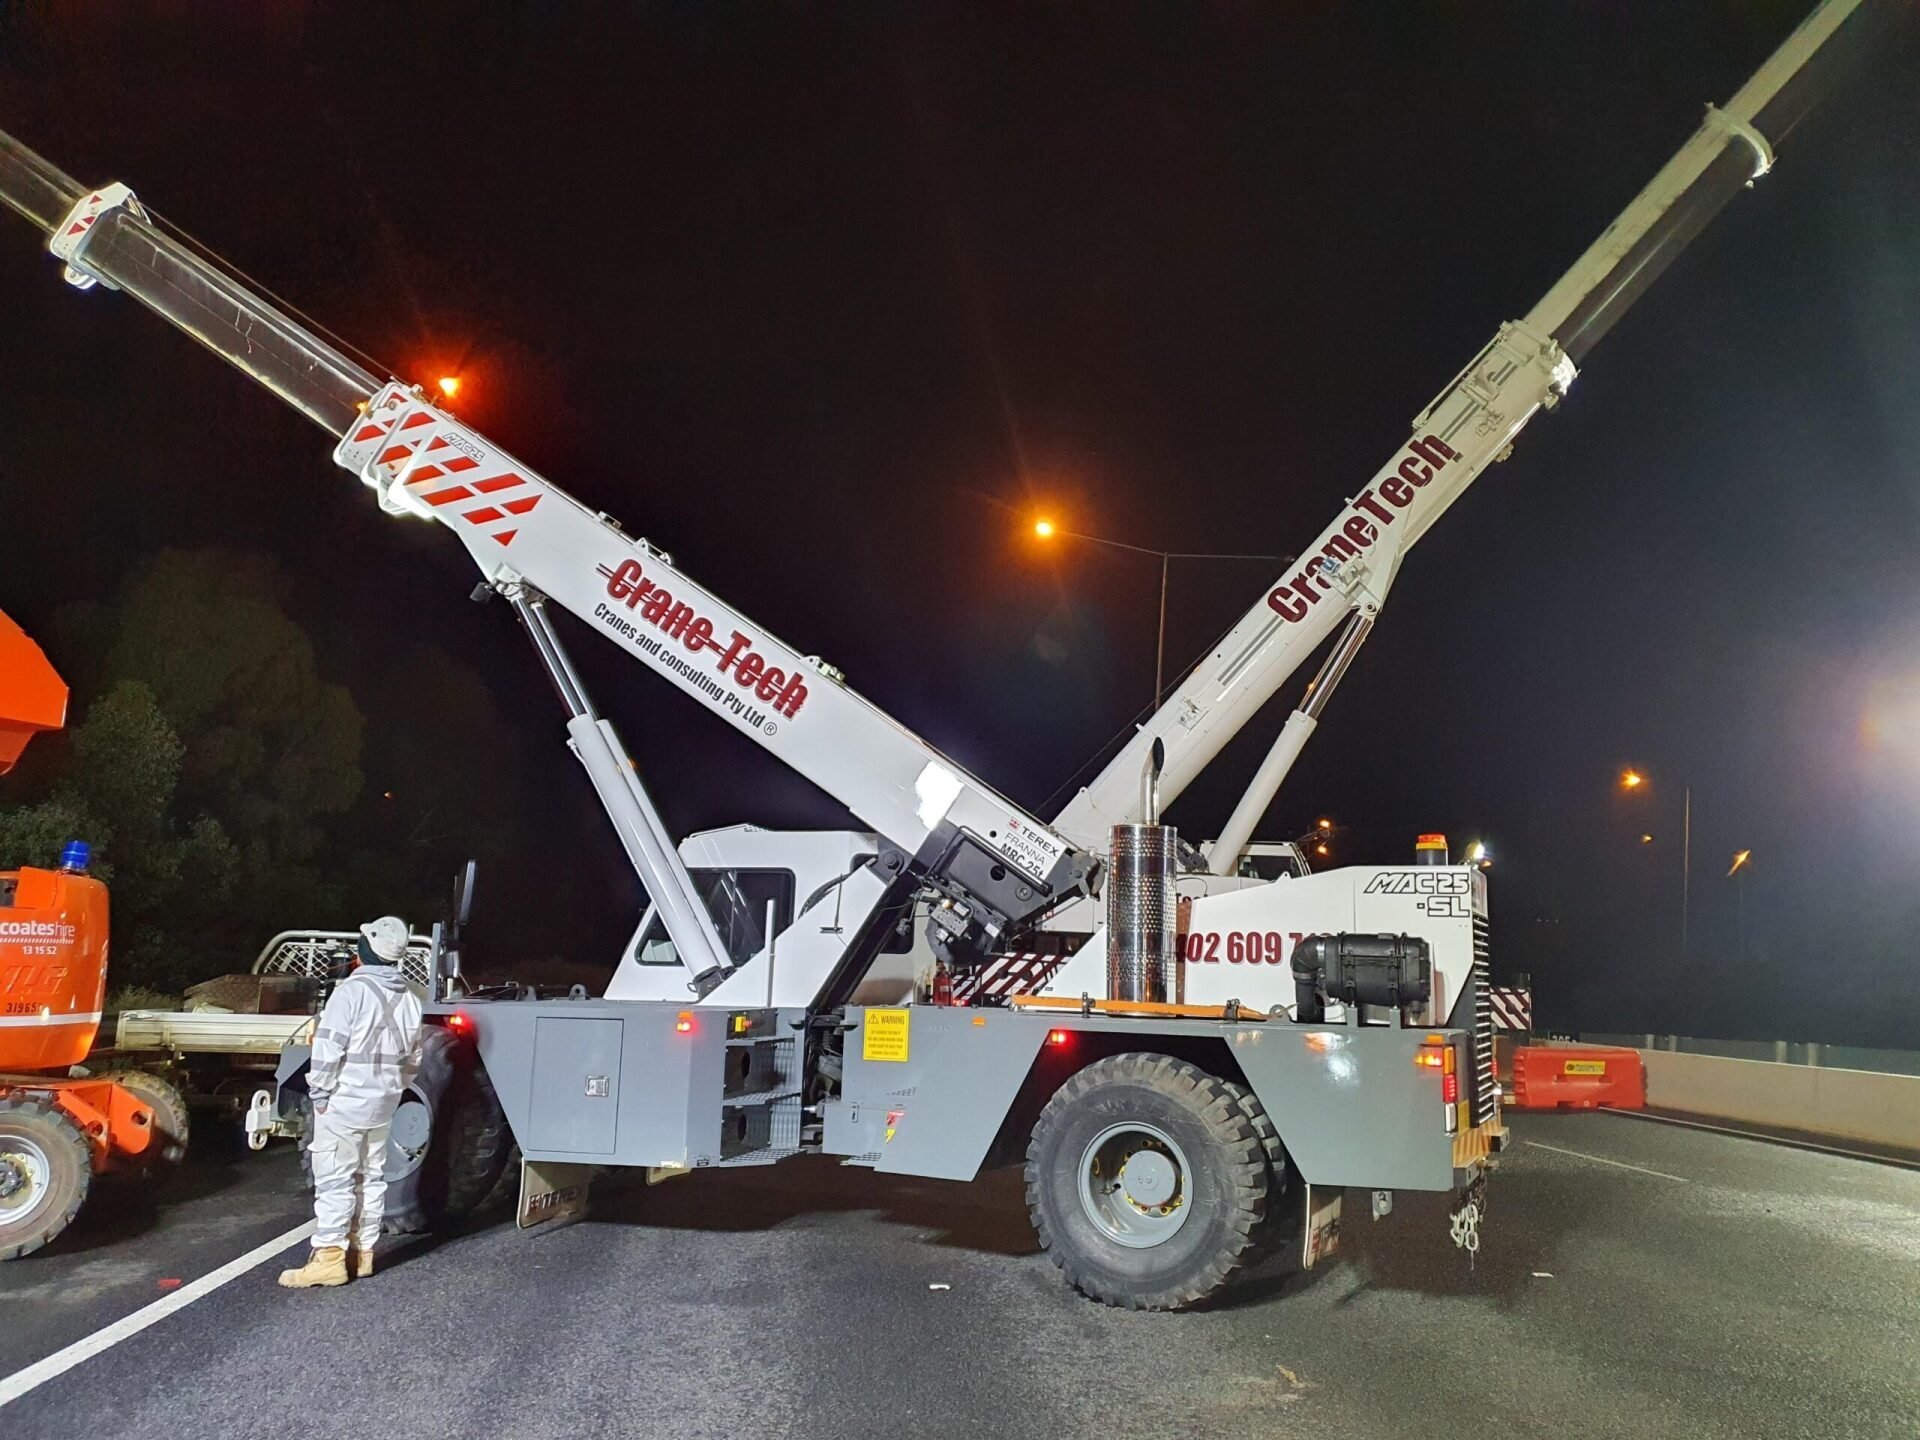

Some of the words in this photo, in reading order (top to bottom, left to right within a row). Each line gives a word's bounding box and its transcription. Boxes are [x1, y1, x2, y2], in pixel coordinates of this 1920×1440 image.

[594, 602, 638, 640] Cranes
[635, 632, 661, 656] and
[659, 650, 726, 701] consulting
[722, 691, 747, 716] Pty
[743, 705, 766, 729] Ltd
[1000, 842, 1025, 866] MRC
[1005, 832, 1046, 866] FRANNA
[1022, 825, 1060, 857] TEREX
[22, 945, 33, 955] 13
[35, 945, 44, 955] 15
[46, 945, 57, 955] 52
[1186, 932, 1221, 964] 02
[1226, 931, 1283, 965] 609
[880, 1015, 905, 1025] WARNING
